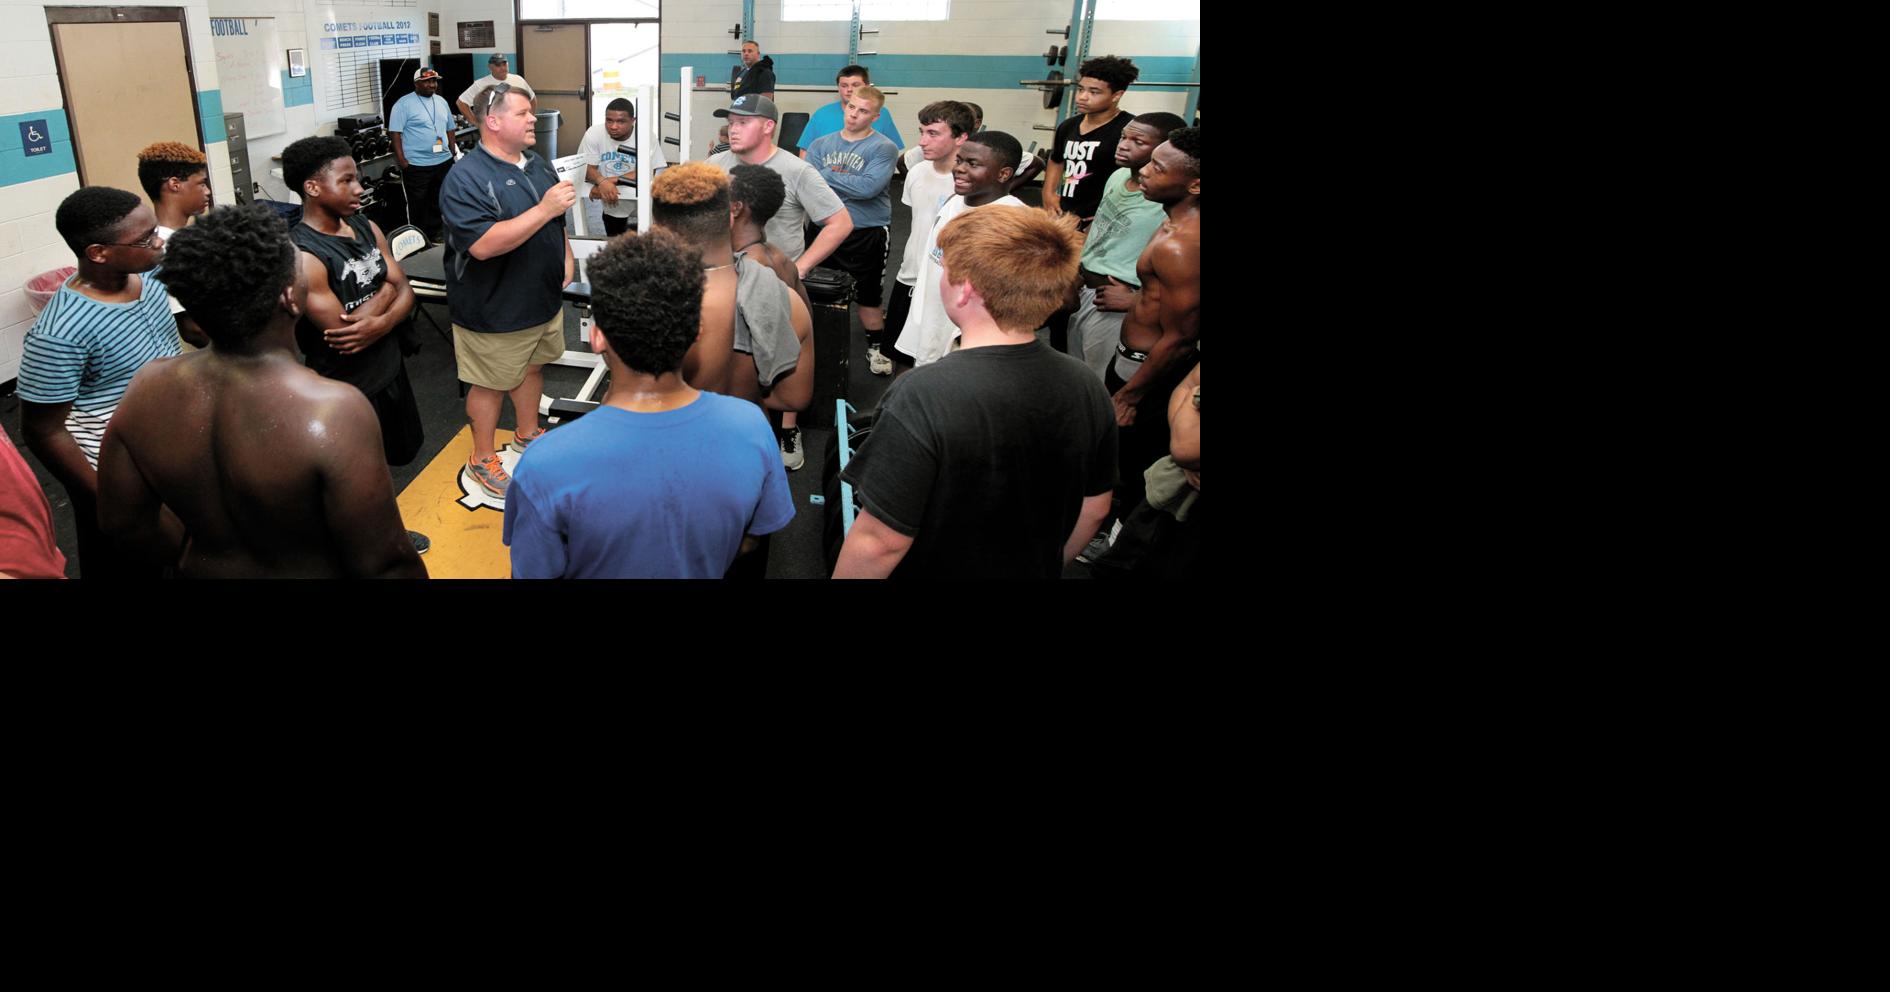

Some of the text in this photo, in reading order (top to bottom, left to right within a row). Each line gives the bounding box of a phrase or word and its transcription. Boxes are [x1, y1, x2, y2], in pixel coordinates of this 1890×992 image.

[210, 19, 249, 36] FOOTBALL
[324, 22, 359, 33] COMETS
[360, 21, 395, 31] OOTBALL
[1063, 140, 1101, 160] JUST
[1065, 159, 1087, 180] DO
[1062, 178, 1080, 197] IT
